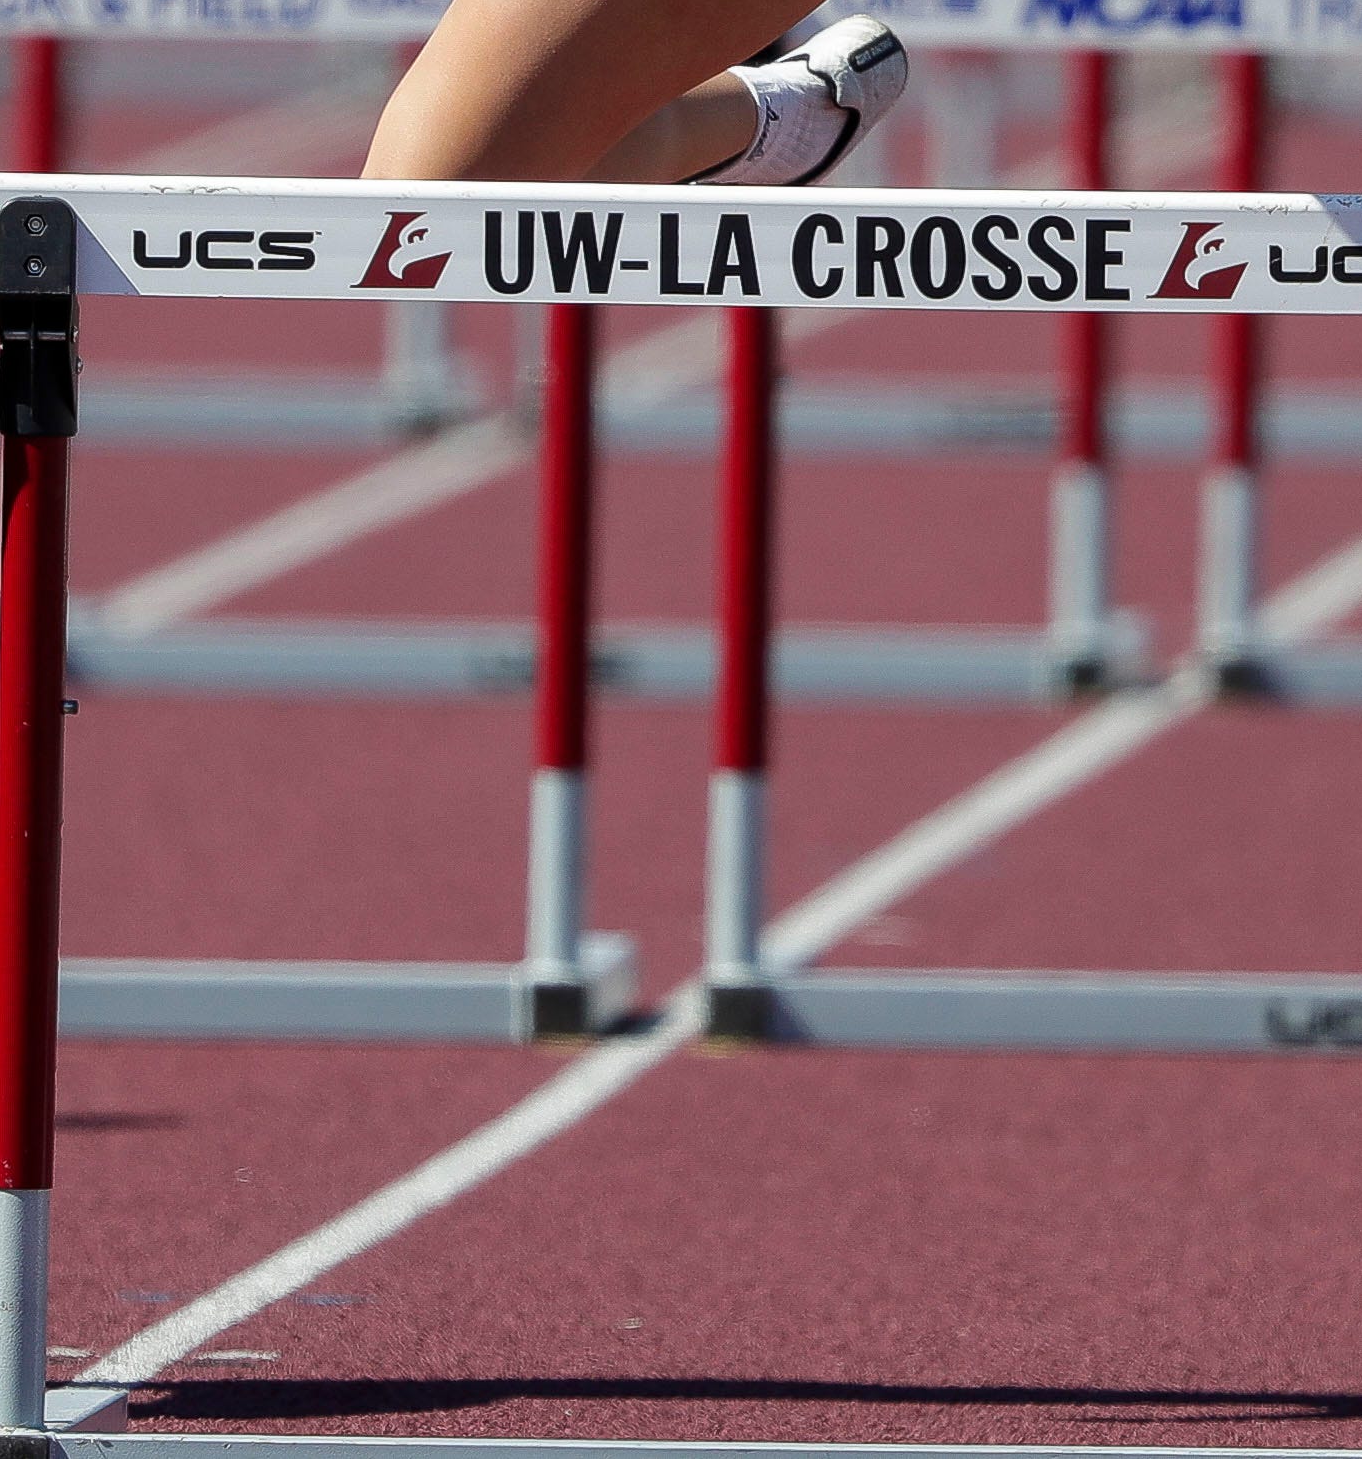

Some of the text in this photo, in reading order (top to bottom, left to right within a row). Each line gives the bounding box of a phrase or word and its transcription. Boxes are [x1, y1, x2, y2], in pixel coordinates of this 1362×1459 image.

[133, 230, 317, 271] UCS
[484, 210, 761, 297] UW-LA
[790, 214, 1131, 302] CROSSE
